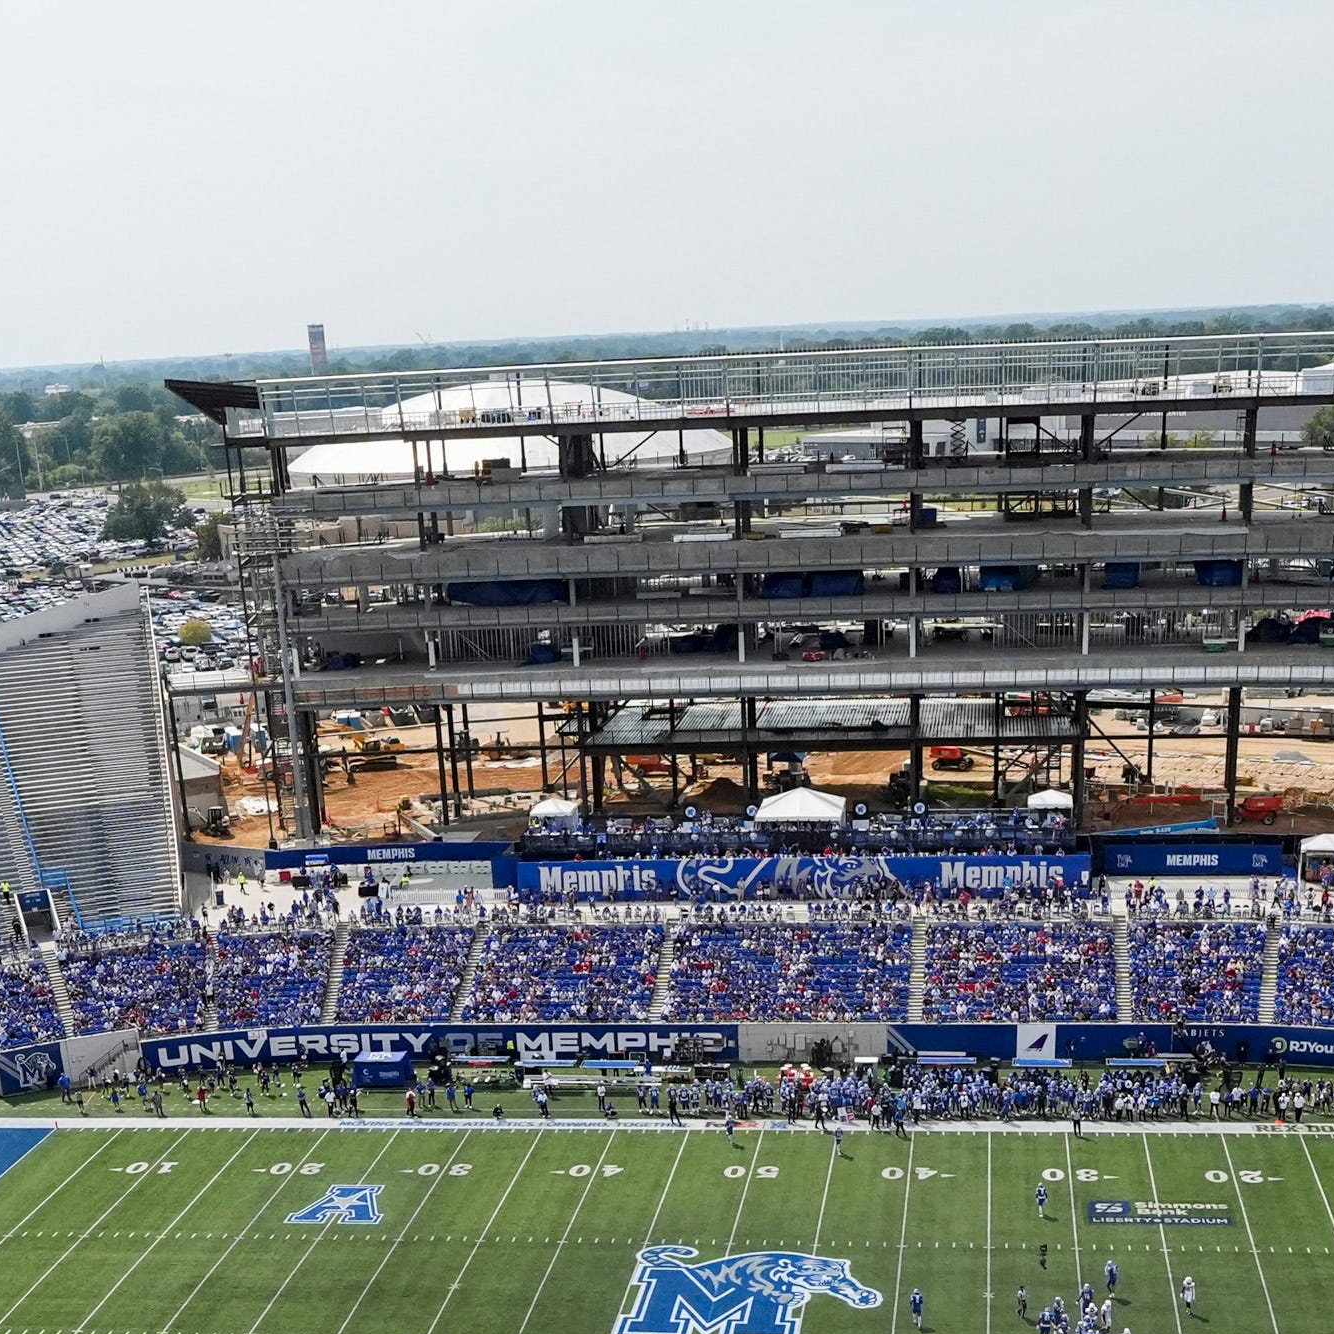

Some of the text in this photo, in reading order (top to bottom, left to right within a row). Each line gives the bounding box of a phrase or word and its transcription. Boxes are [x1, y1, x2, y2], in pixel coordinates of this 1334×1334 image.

[367, 847, 415, 860] MEMPHIS
[1166, 854, 1219, 867] MEMPHIS
[538, 865, 656, 896] Memphis
[940, 861, 1063, 889] Memphis
[158, 1033, 431, 1067] UNIVERSITY
[439, 1033, 503, 1053] OF
[1255, 1124, 1300, 1133] REX
[126, 1161, 179, 1174] 10
[269, 1162, 325, 1175] 20
[418, 1163, 472, 1177] 30
[569, 1164, 624, 1178] 40
[723, 1165, 780, 1179] 50
[882, 1167, 937, 1180] 40
[1041, 1168, 1099, 1182] 30
[1205, 1170, 1264, 1184] 20
[1134, 1201, 1229, 1210] Simmons
[1137, 1208, 1189, 1217] Bank
